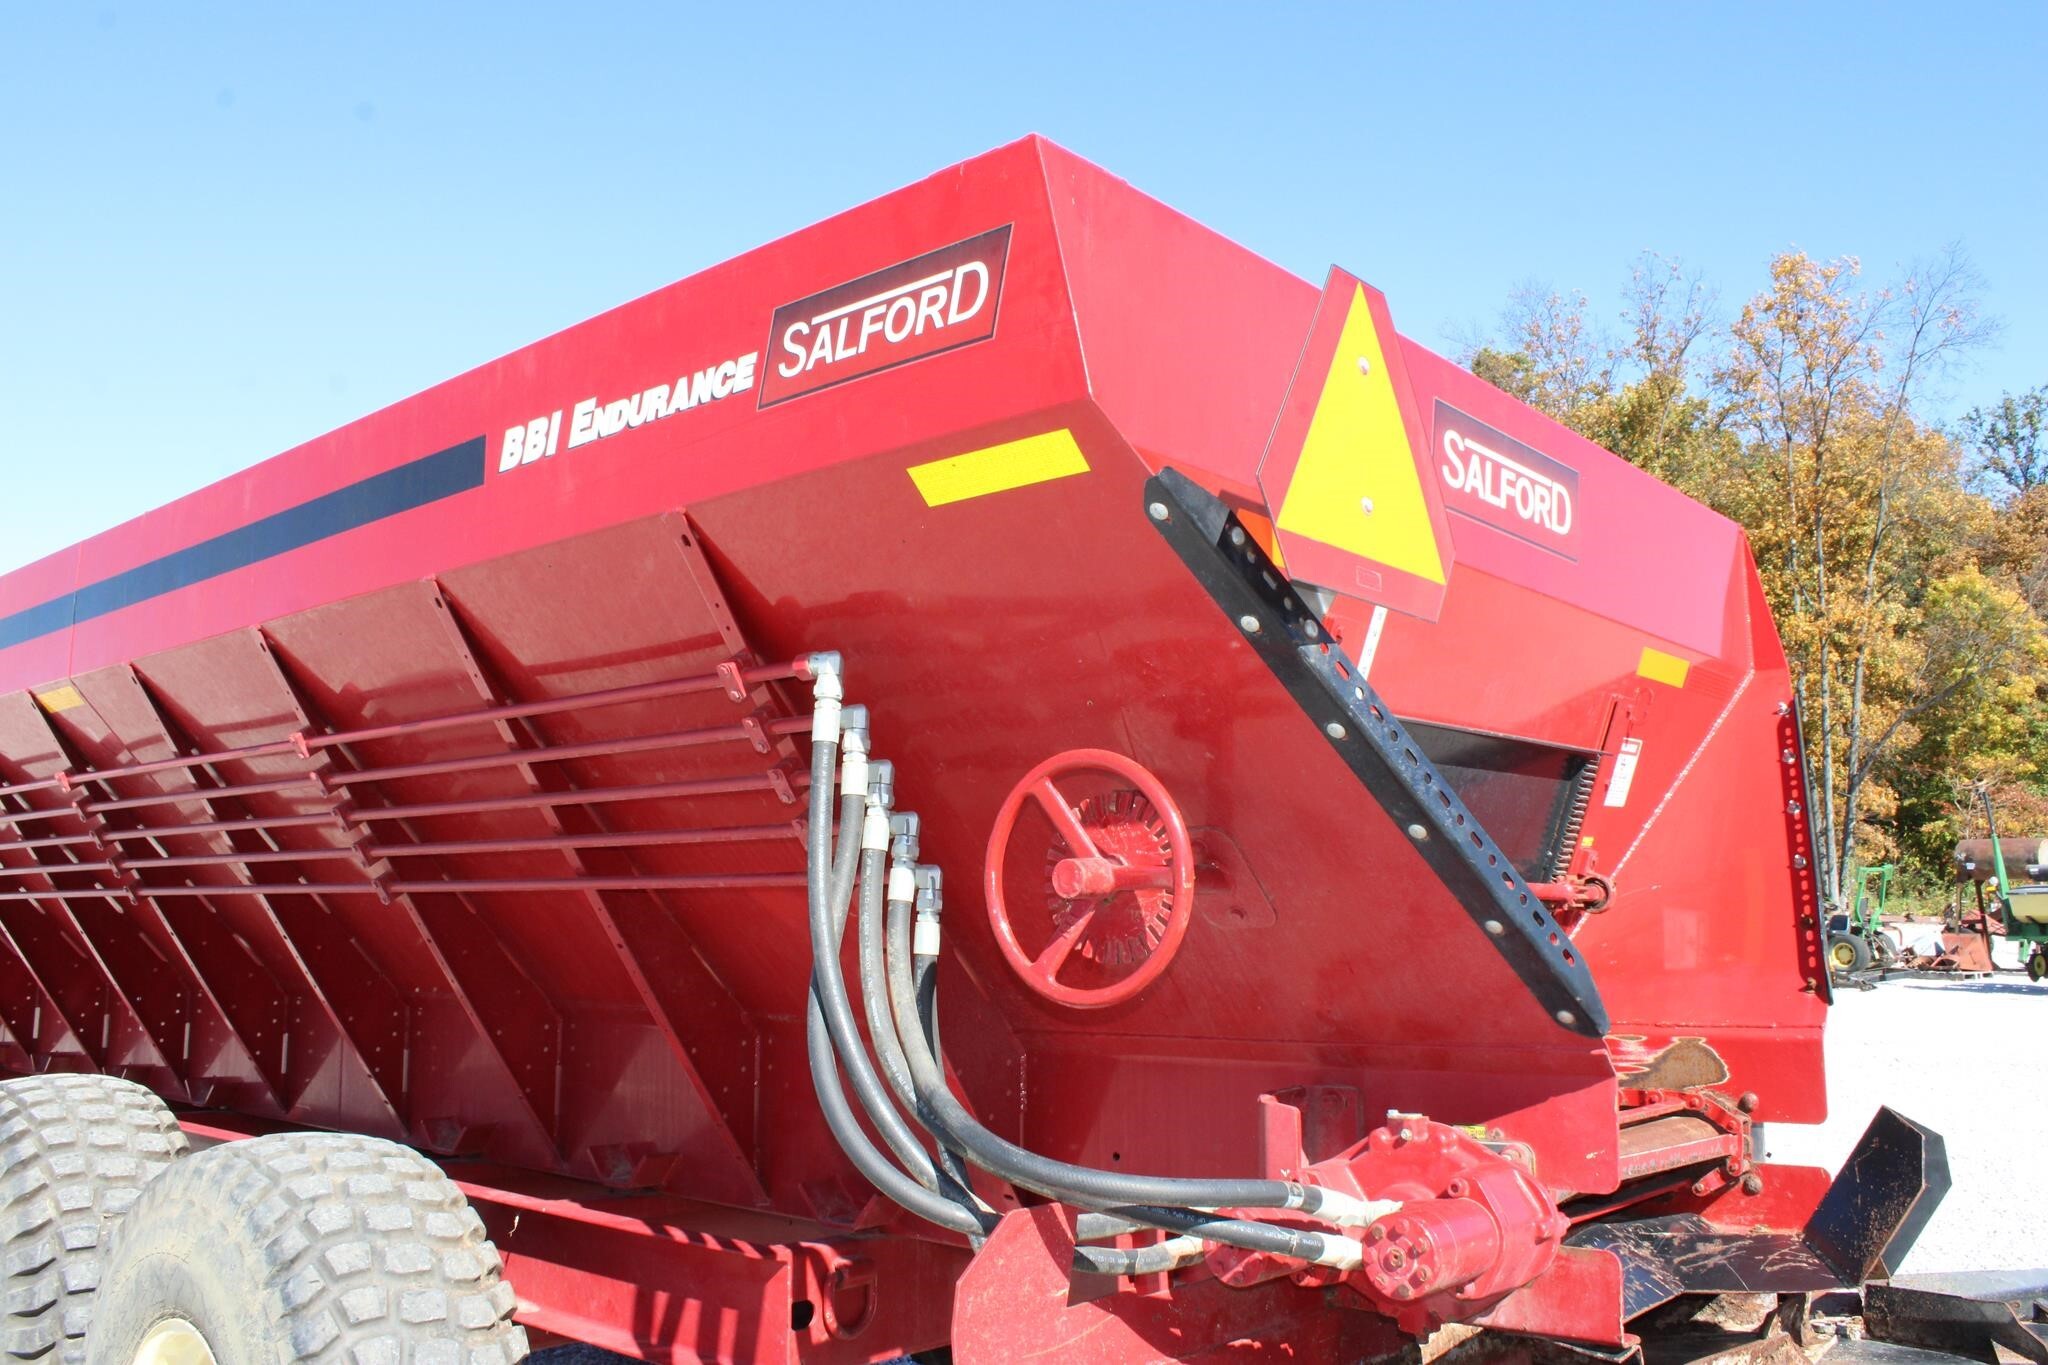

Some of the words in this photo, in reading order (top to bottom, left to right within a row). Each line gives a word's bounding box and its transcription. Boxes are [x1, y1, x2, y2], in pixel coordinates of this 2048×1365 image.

[778, 260, 989, 378] SALFORD
[498, 409, 563, 473] BBI
[567, 350, 758, 450] ENDURANCE
[1442, 429, 1572, 535] SALFORD
